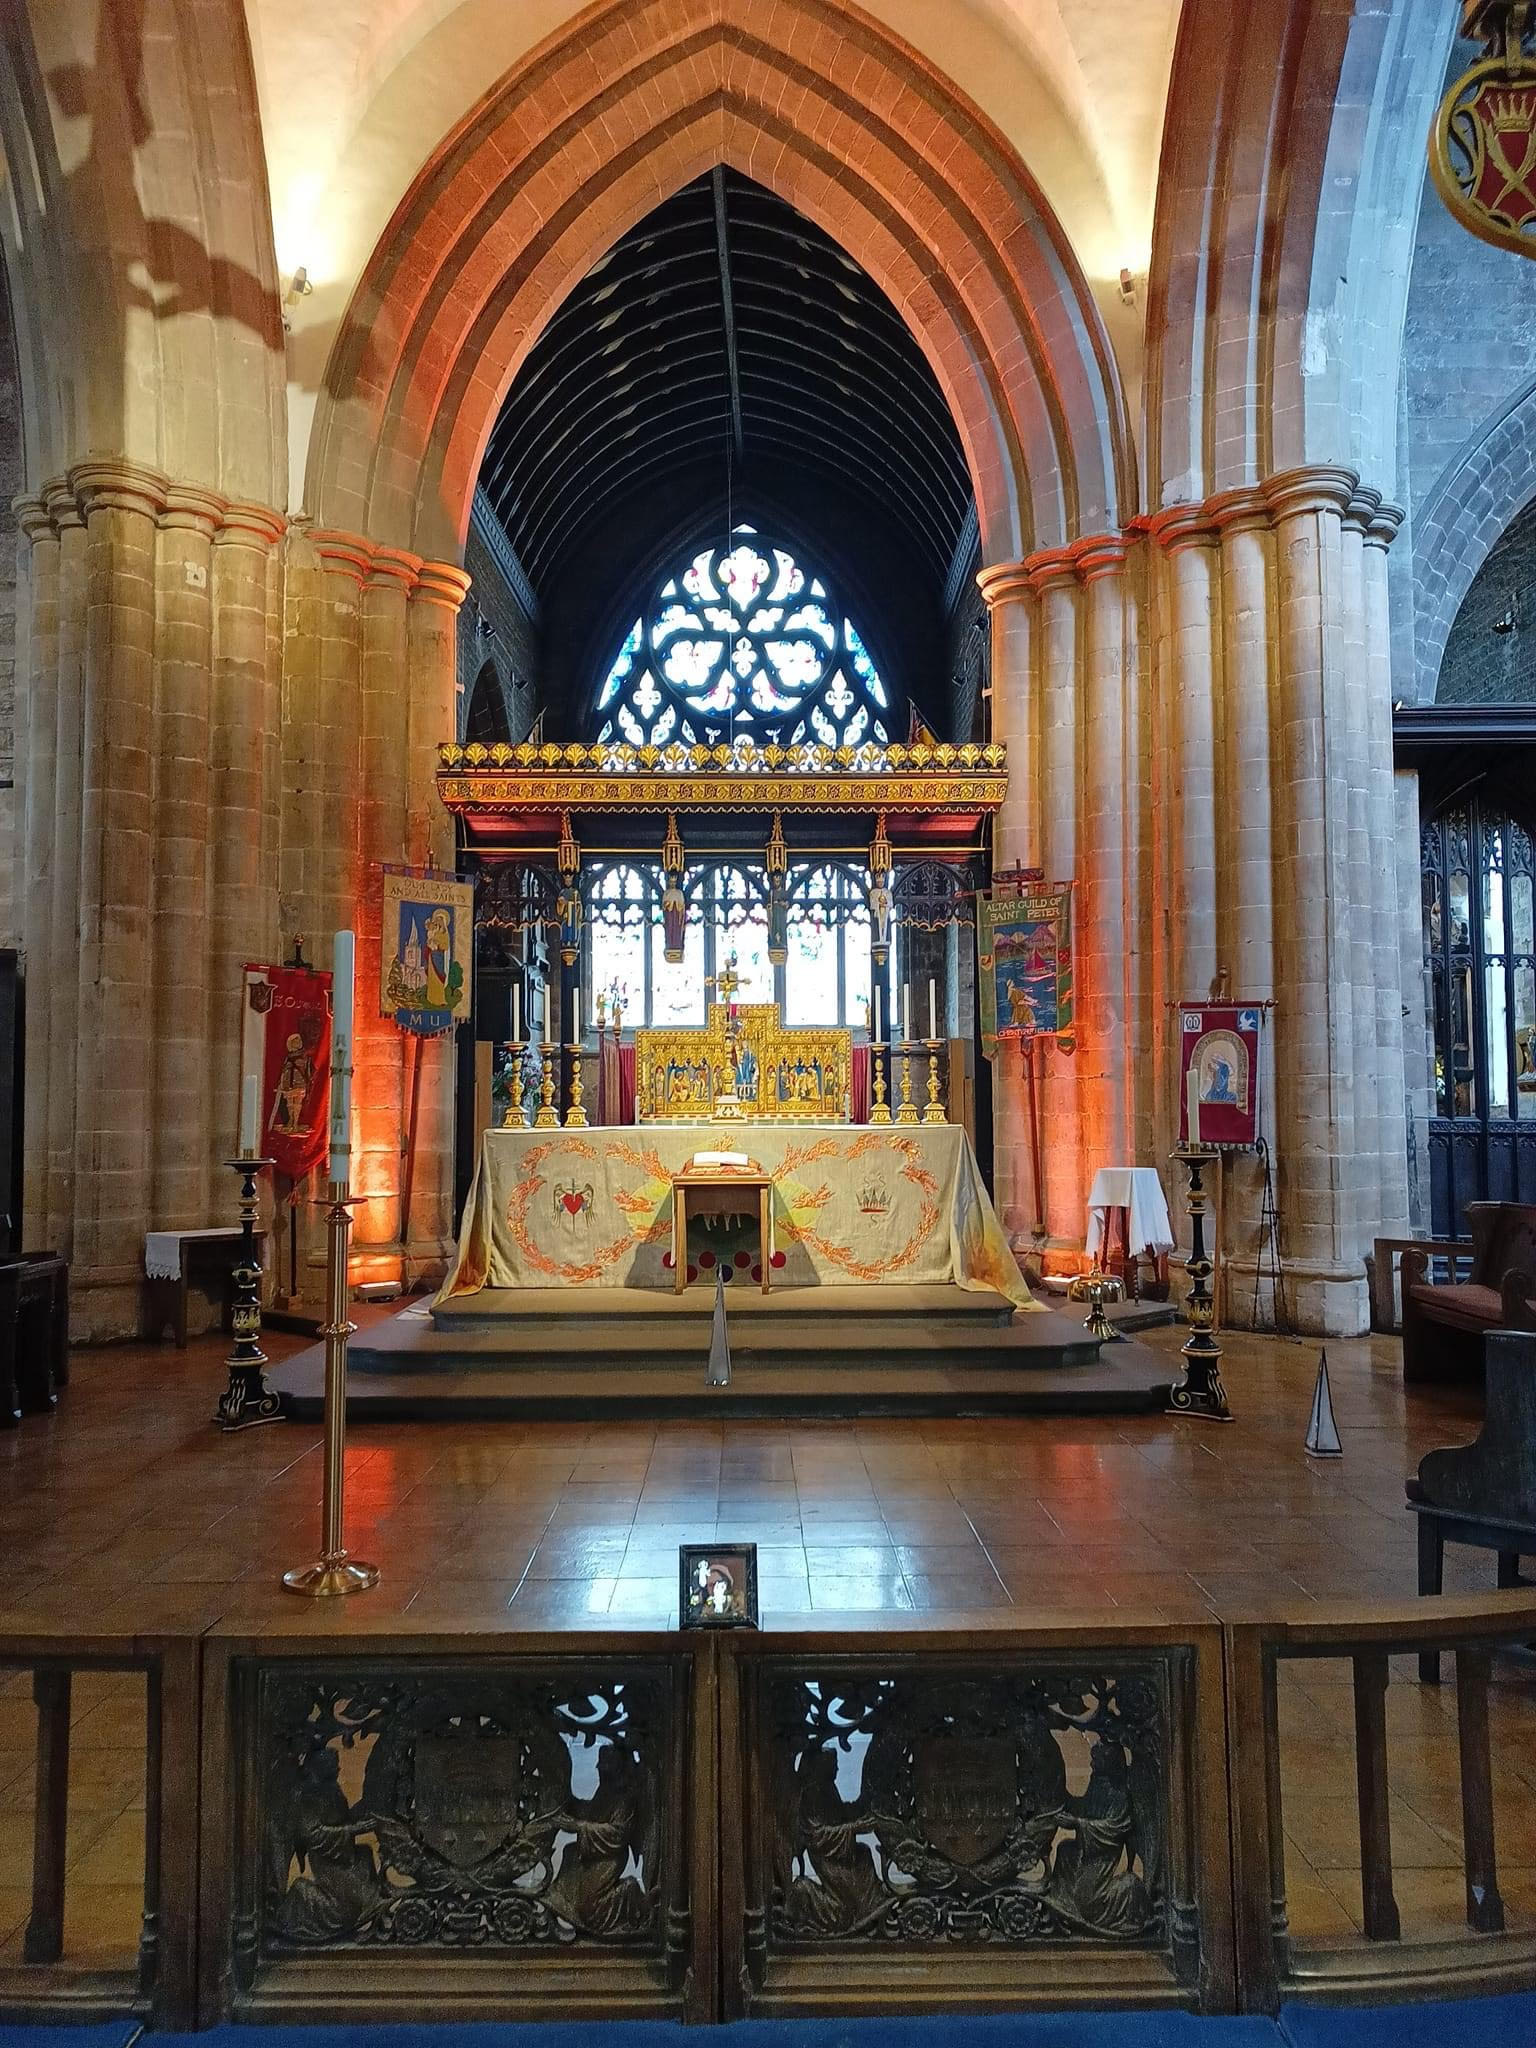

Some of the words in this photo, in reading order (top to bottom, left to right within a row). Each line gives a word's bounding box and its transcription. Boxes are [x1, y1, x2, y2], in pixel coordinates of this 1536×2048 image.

[986, 900, 1016, 912] ALTAR
[1017, 898, 1047, 909] GUILD
[1049, 896, 1062, 906] OF
[990, 910, 1020, 921] SAINT
[1027, 907, 1060, 918] PETER
